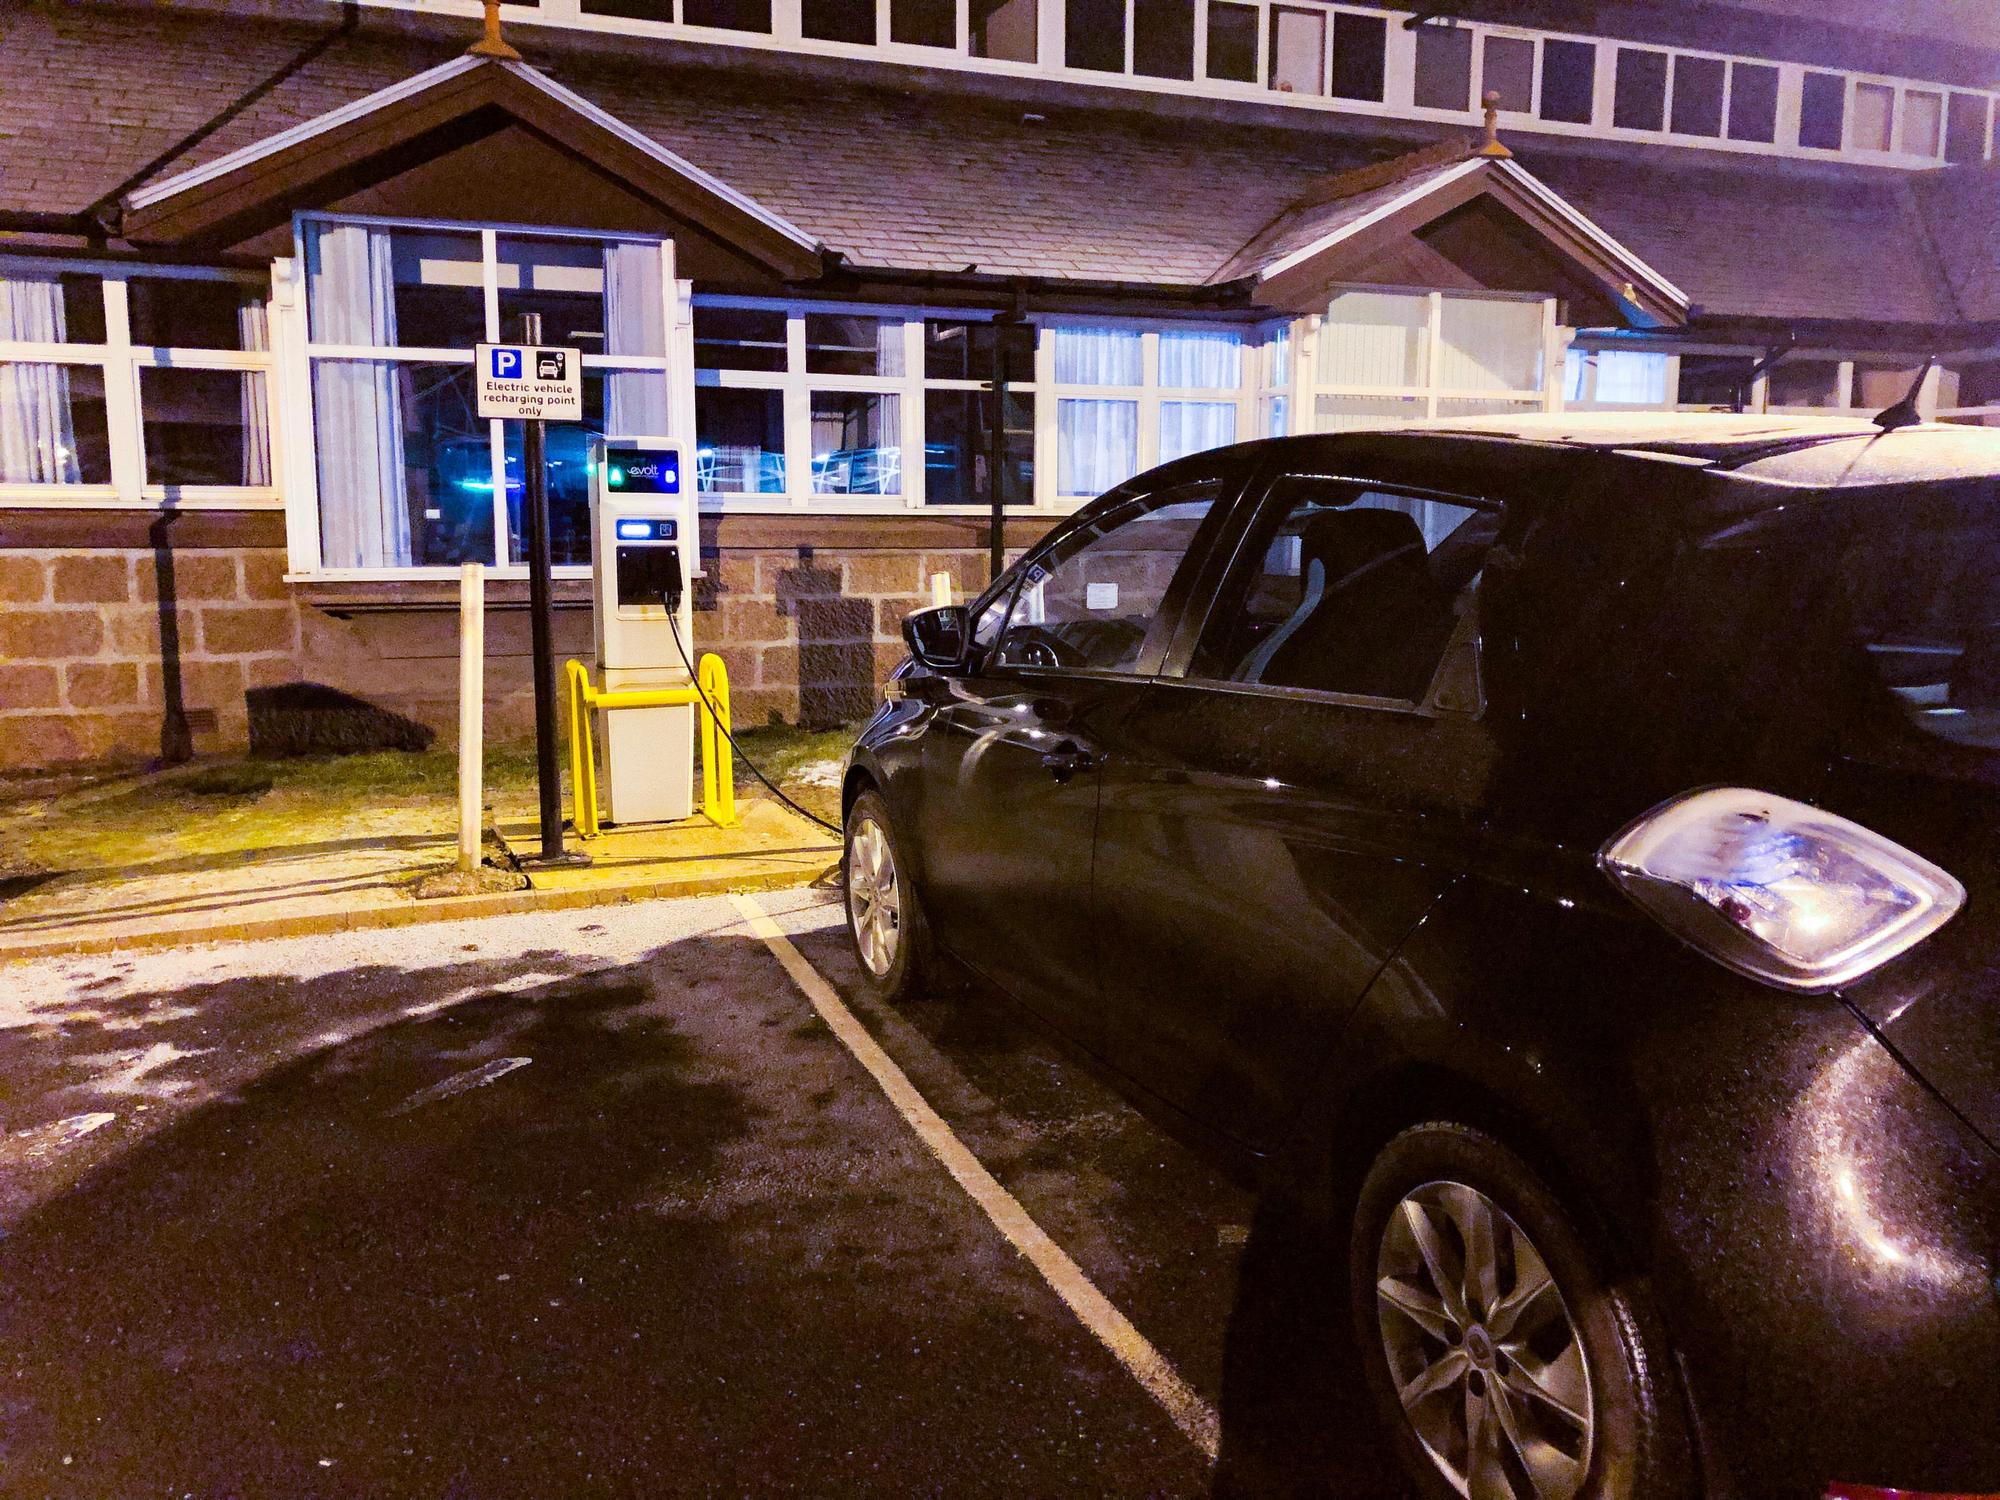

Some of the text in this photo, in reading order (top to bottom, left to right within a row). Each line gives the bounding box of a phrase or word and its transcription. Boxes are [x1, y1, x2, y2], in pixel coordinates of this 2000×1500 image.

[498, 352, 516, 375] P
[487, 382, 573, 394] Electric vehicle
[484, 394, 575, 406] recharging point
[519, 406, 542, 416] only
[611, 468, 622, 482] A
[627, 464, 659, 475] evolt
[665, 470, 676, 483] B
